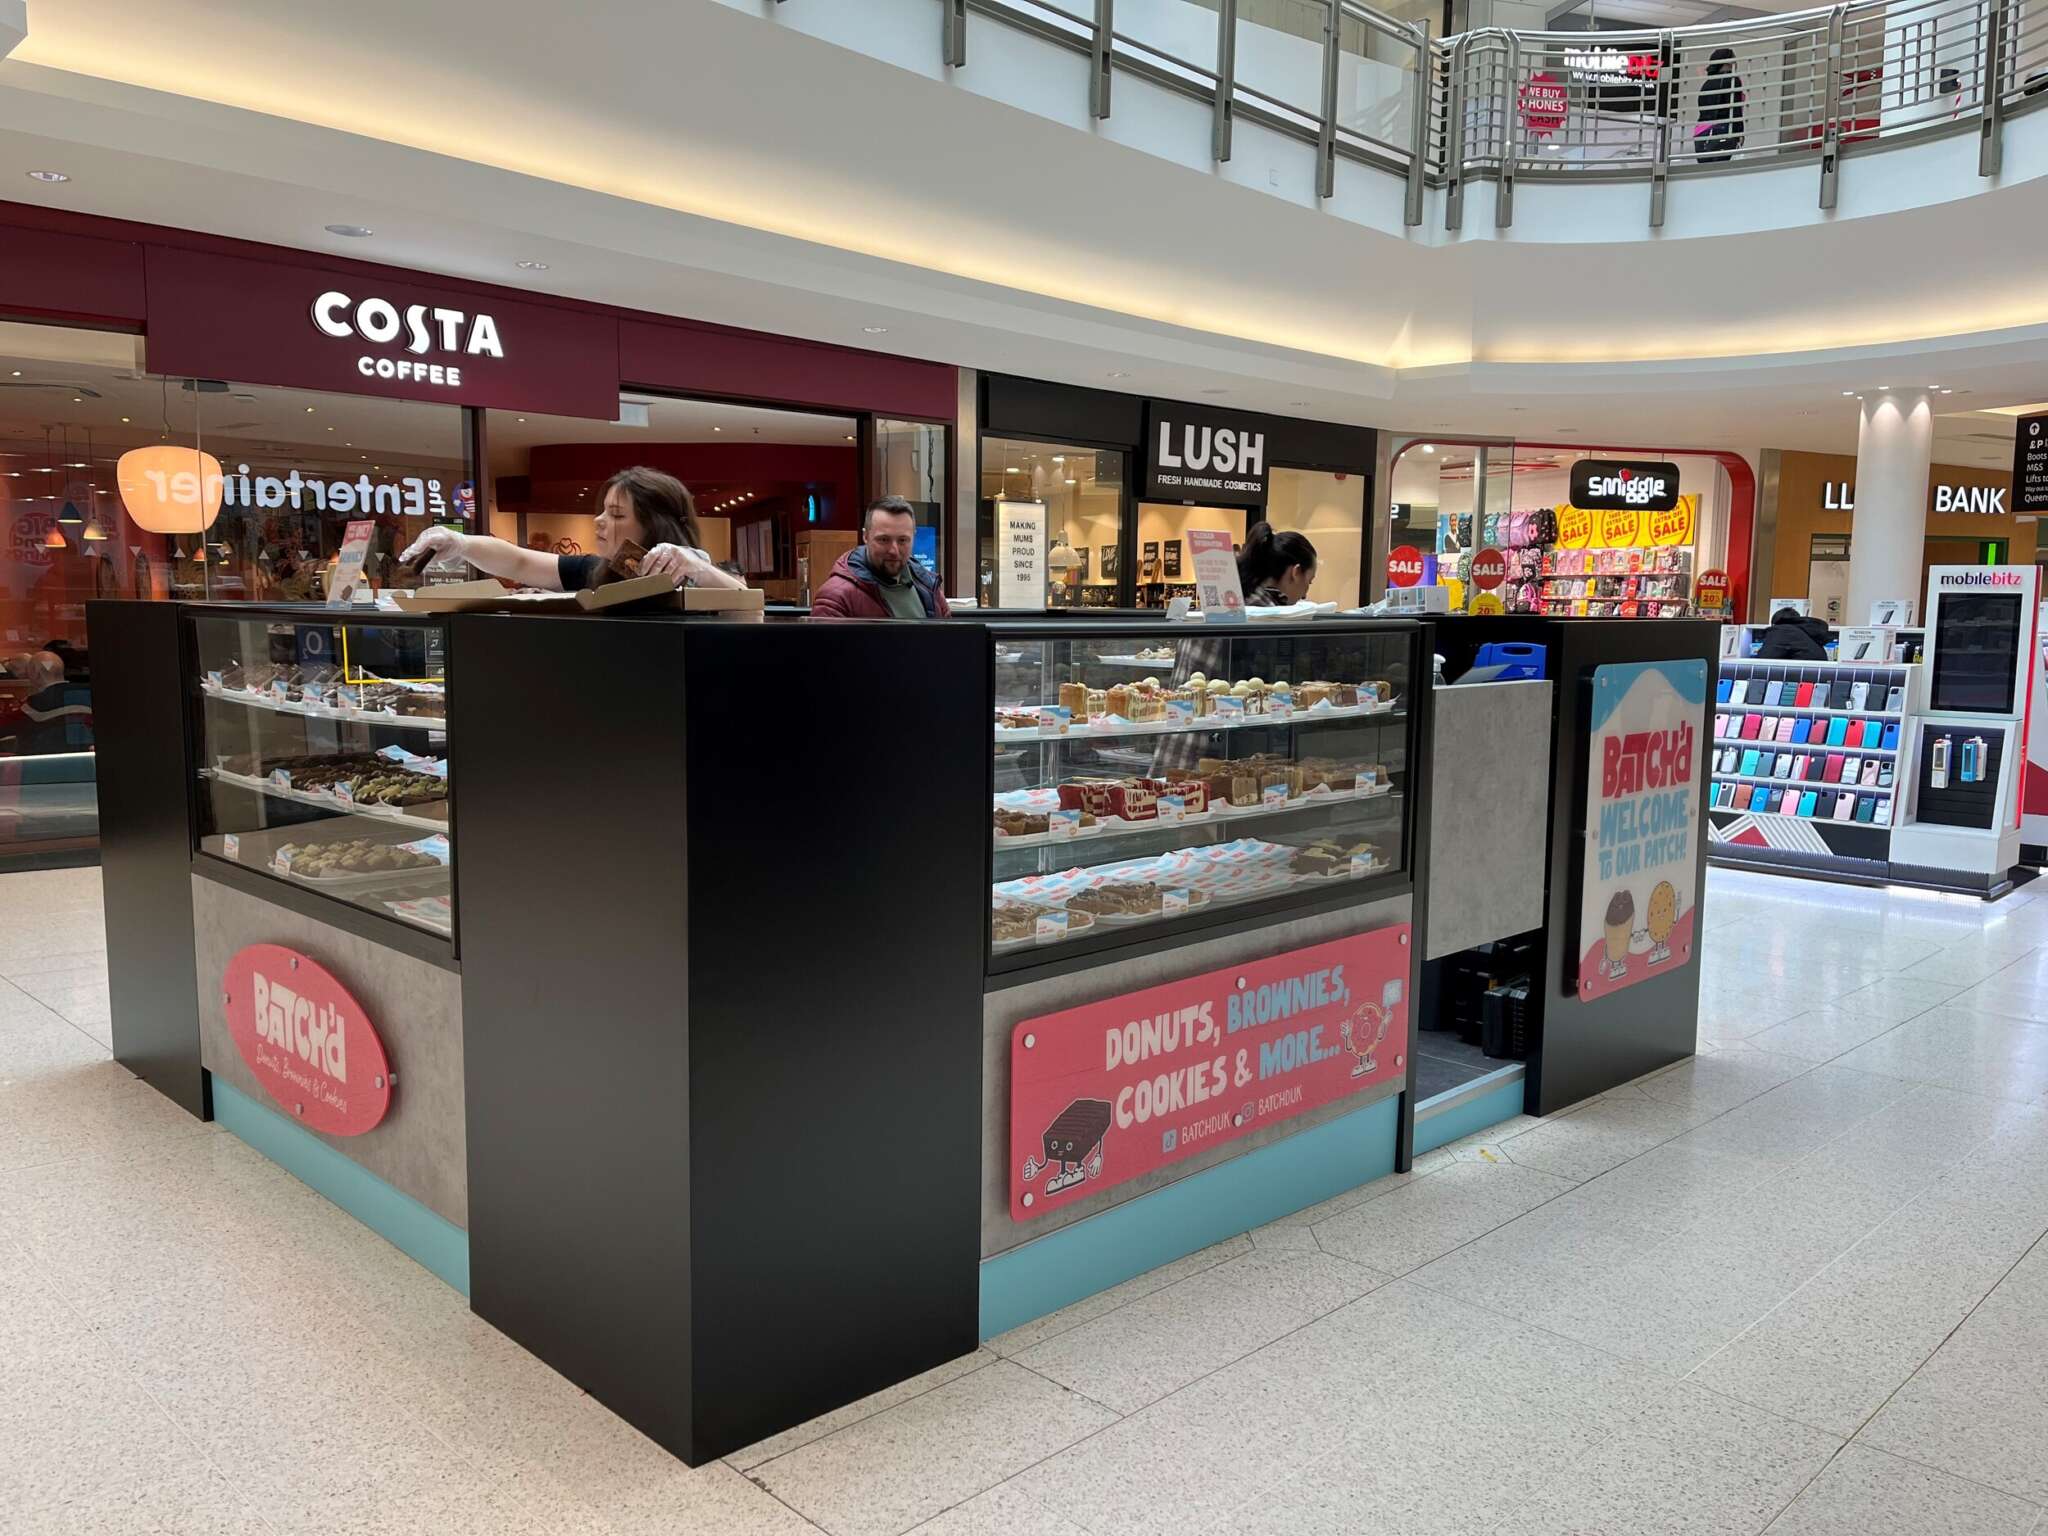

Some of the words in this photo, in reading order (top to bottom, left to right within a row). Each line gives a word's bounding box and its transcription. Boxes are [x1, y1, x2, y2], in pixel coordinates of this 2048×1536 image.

[1542, 88, 1561, 98] BUY
[311, 291, 504, 357] COSTA
[358, 356, 461, 386] COFFEE
[1159, 421, 1264, 475] LUSH
[2027, 452, 2048, 461] Boots
[2027, 463, 2044, 472] M&S
[1158, 474, 1182, 485] FRESH
[1184, 476, 1223, 489] HANDMADE
[1224, 480, 1262, 492] COSMETICS
[2025, 474, 2041, 483] Lifts
[1935, 485, 2006, 514] BANK
[1009, 521, 1036, 530] MAKING
[1563, 522, 1588, 542] SALE
[1606, 519, 1634, 540] SALE
[1653, 516, 1685, 539] SALE
[1013, 535, 1033, 543] MUMS
[1012, 547, 1035, 556] PROUD
[1014, 560, 1033, 569] SINCE
[1388, 560, 1423, 574] SALE
[1472, 563, 1506, 576] SALE
[1699, 575, 1728, 587] SALE
[1941, 572, 2022, 585] mobilebitz
[1600, 789, 1690, 848] WELCOME
[1615, 843, 1641, 877] OUR
[1644, 830, 1688, 868] PATCH!
[1105, 1001, 1220, 1071] DONUTS,
[1227, 965, 1350, 1034] BROWNIES,
[1115, 1055, 1228, 1129] COOKIES
[1234, 1048, 1253, 1088] &
[1259, 1024, 1341, 1081] MORE...
[1182, 1111, 1231, 1145] BATCHDUK
[1258, 1085, 1303, 1116] BATCHDUK
